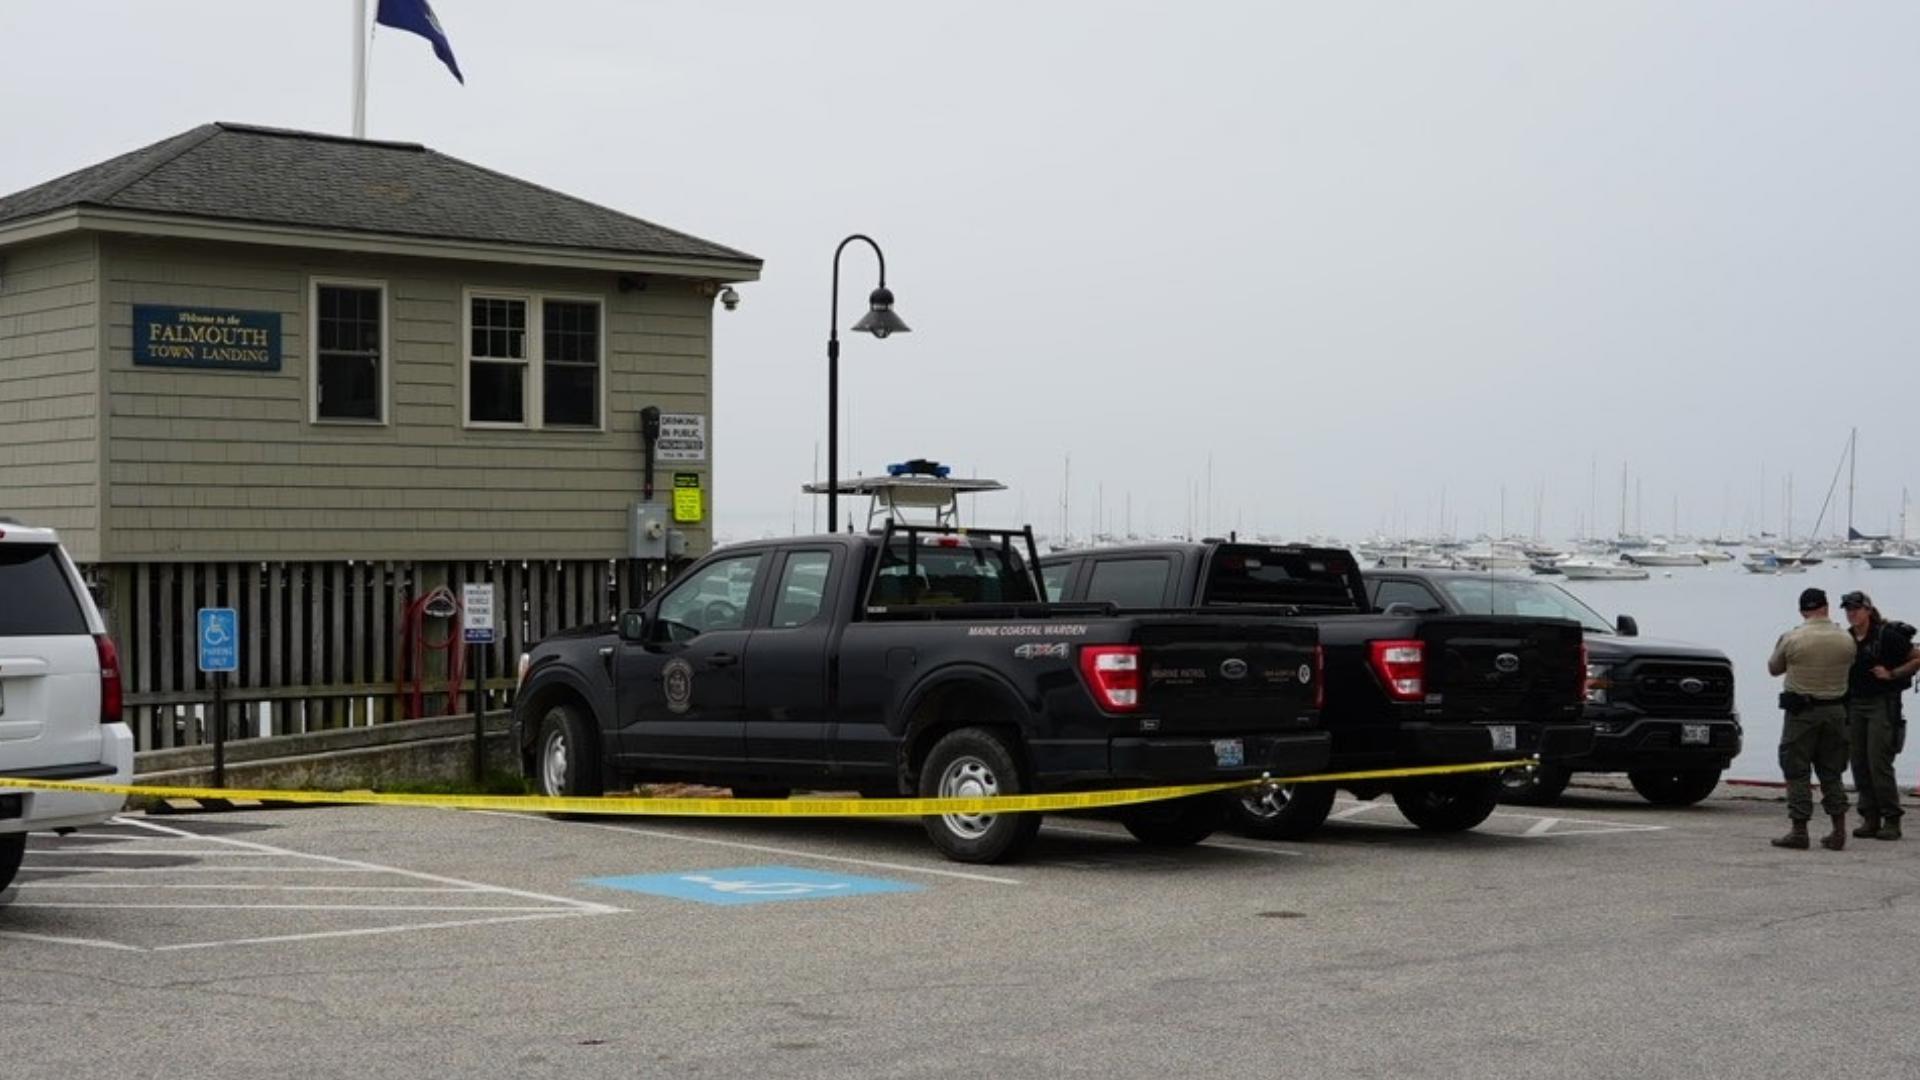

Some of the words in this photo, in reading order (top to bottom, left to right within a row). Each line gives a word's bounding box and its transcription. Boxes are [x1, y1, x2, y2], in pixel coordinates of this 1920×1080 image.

[178, 313, 214, 323] Welcome
[217, 315, 225, 324] to
[227, 315, 241, 325] the
[149, 323, 268, 346] FALMOUTH
[148, 344, 195, 359] TOWN
[202, 348, 269, 362] LANDING
[662, 416, 699, 426] DRINKING
[662, 428, 671, 437] IN
[673, 428, 699, 437] PUBLIC
[968, 626, 1000, 636] MAINE
[1000, 625, 1042, 636] COASTAL
[1044, 624, 1088, 636] WARDEN
